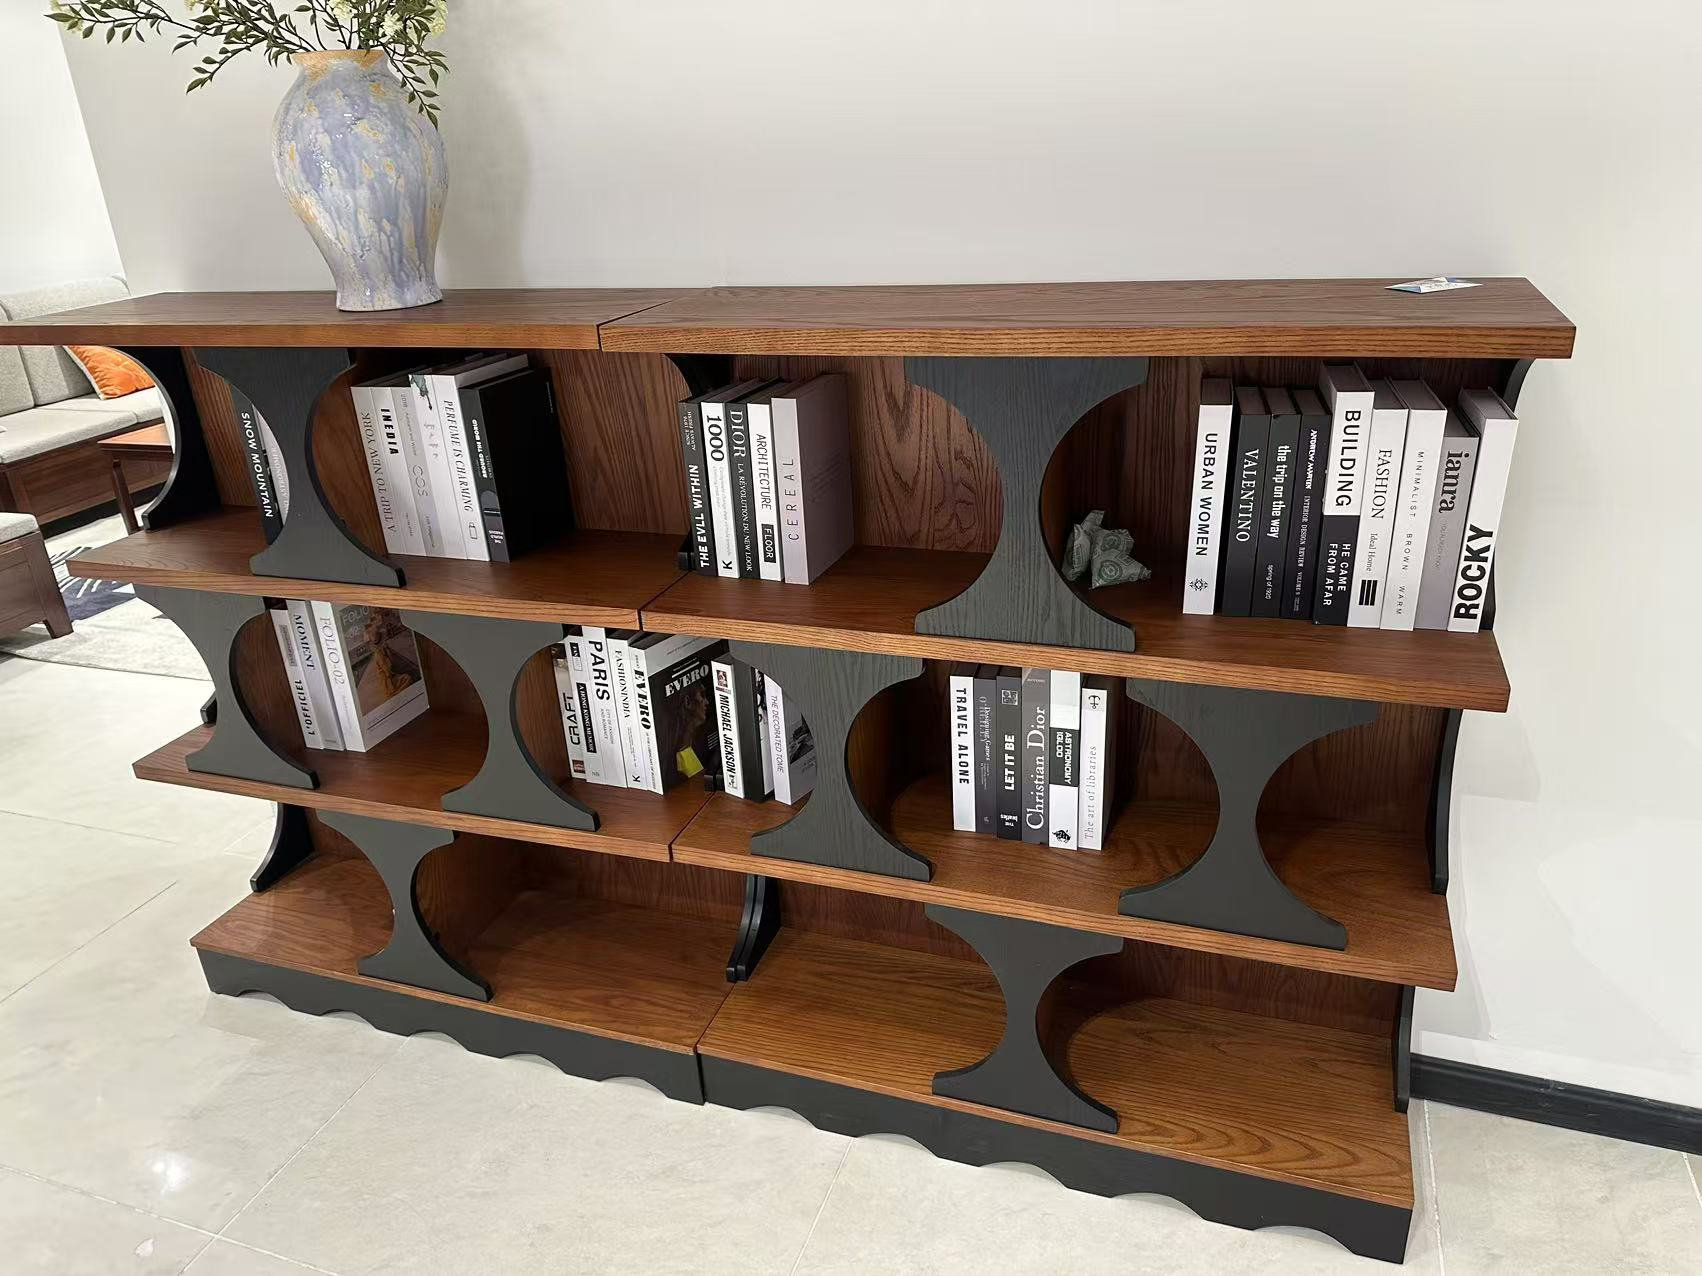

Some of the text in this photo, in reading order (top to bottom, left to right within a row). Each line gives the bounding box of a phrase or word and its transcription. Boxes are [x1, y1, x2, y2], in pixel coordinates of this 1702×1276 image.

[361, 412, 375, 445] YORK
[381, 409, 399, 455] INEDIA
[706, 415, 725, 461] 1000
[729, 410, 746, 457] DIOR
[241, 412, 274, 517] SNOW MOUNTAIN
[369, 448, 382, 475] NEW
[444, 400, 473, 512] PERFUME IS CHARMING
[737, 464, 744, 473] LA
[756, 434, 772, 510] ARCHITECTURE
[1336, 410, 1361, 507] BUILDING
[375, 478, 385, 495] TO
[412, 465, 428, 497] COS
[688, 465, 703, 508] WITHIN
[739, 476, 748, 521] RÉVOLUTION
[782, 460, 799, 541] CEREAL
[1196, 433, 1218, 556] URBAN WOMEN
[1235, 449, 1259, 542] VALENTINO
[1267, 445, 1291, 538] the trip on the way
[1371, 449, 1392, 519] FASHION
[1439, 451, 1469, 513] ianra
[380, 496, 394, 523] TRIP
[743, 523, 750, 533] DU
[1302, 496, 1310, 522] INTERIOR
[698, 546, 710, 567] THE
[764, 528, 773, 558] FLOOR
[1366, 533, 1377, 572] Ideal Home
[1395, 451, 1425, 616] MINIMALIST BROWN WARM
[722, 560, 732, 569] K
[1266, 564, 1274, 579] spring
[1323, 543, 1337, 606] FROM AFAR
[1337, 543, 1351, 592] HE CAME
[1453, 524, 1493, 619] ROCKY
[293, 615, 316, 670] MOMENT
[589, 641, 610, 700] PARIS
[615, 650, 630, 719] FASHIONINDIA
[664, 665, 709, 698] EVERO
[294, 680, 316, 735] L'OFFICIEL
[563, 692, 580, 745] CRAFT
[580, 691, 588, 709] HONG
[582, 709, 591, 726] KONG
[634, 669, 651, 730] EVERO
[719, 694, 732, 731] MICHAEL
[722, 734, 736, 774] JACKSON
[771, 696, 784, 773] THE DECORATED TOME
[956, 688, 969, 785] TRAVEL ALONE
[1064, 732, 1072, 784] ASTRONOMY
[1005, 735, 1015, 790] LET IT BE
[1026, 707, 1045, 829] Christian Dior
[1086, 746, 1097, 787] libraries
[1086, 788, 1096, 801] of
[1085, 822, 1095, 839] The
